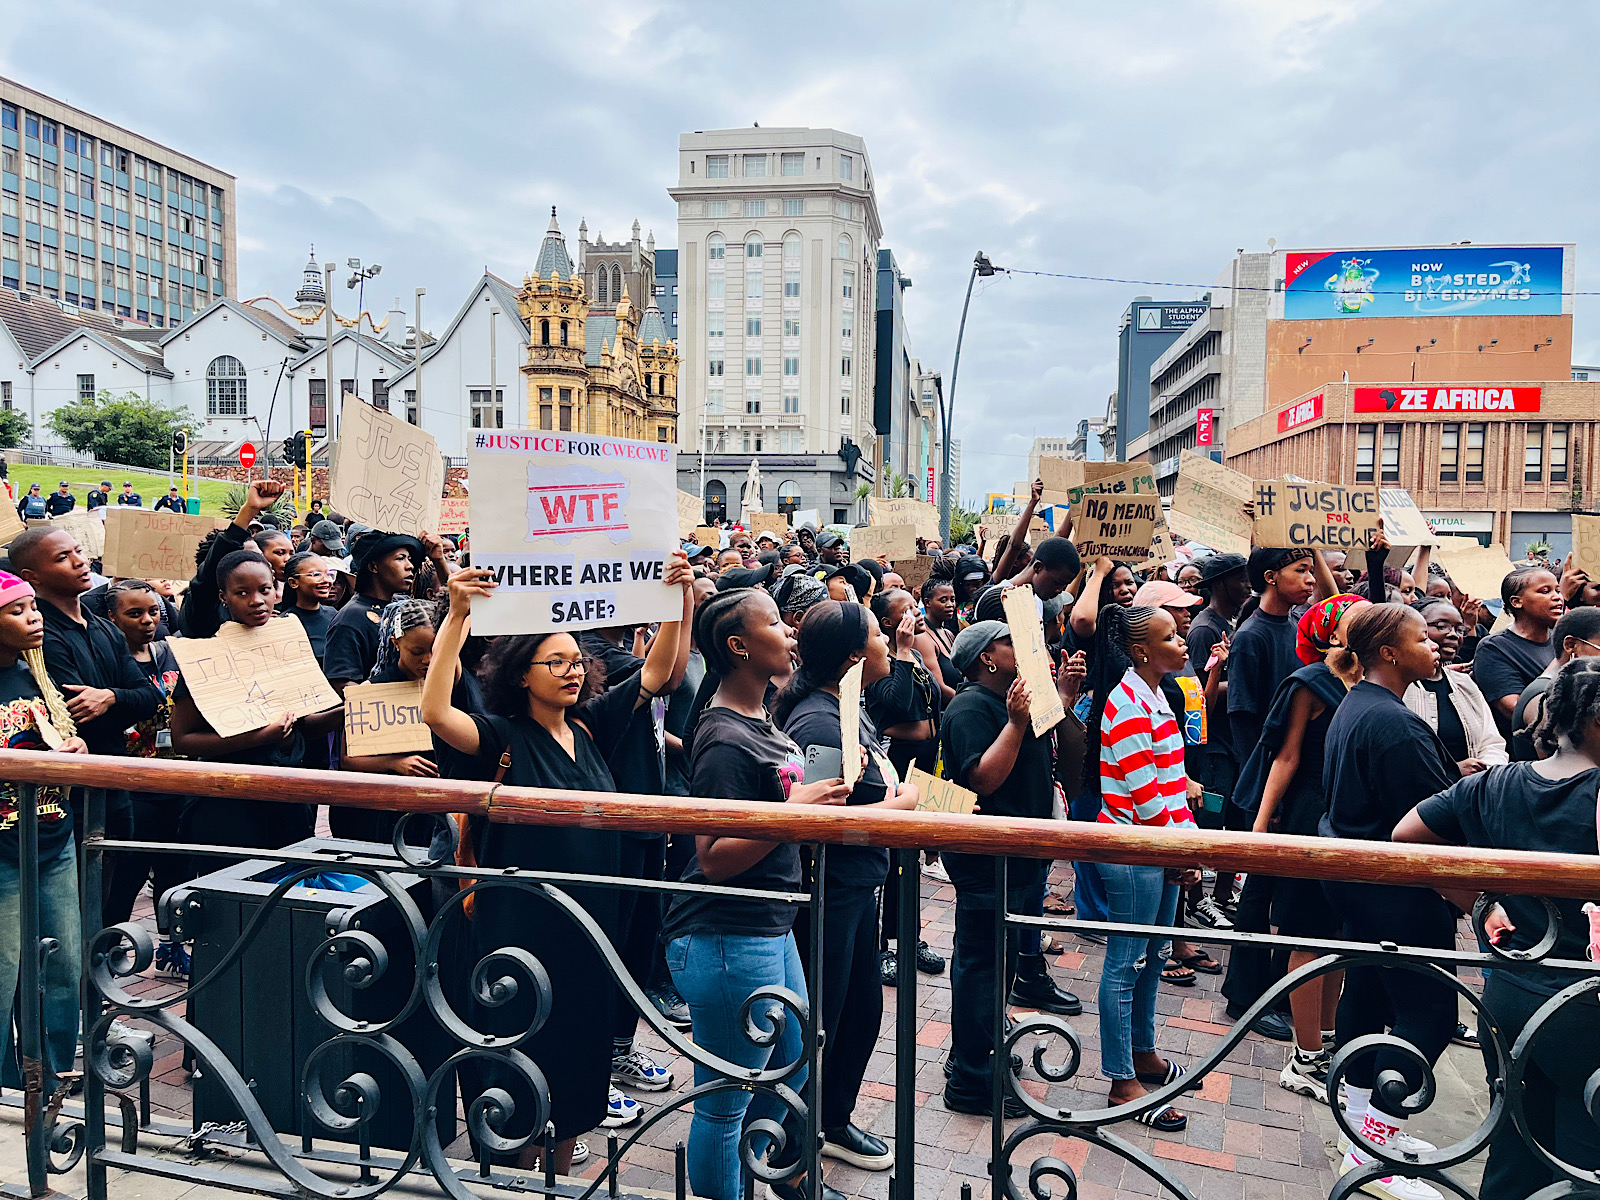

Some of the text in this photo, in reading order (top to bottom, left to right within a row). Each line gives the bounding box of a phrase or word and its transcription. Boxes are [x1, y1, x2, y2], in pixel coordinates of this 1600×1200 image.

[1293, 260, 1309, 275] NEW
[1411, 263, 1443, 272] NOW
[1400, 388, 1515, 410] ZE AFRICA
[1288, 399, 1315, 427] ZE AFRICA
[1199, 412, 1211, 442] KFC
[389, 479, 423, 511] 4
[1286, 485, 1377, 513] JUSTICE
[540, 492, 619, 525] WTF
[1086, 499, 1109, 521] NO
[1326, 512, 1351, 525] FOR
[1099, 521, 1132, 538] NO!!!
[157, 536, 174, 554] 4
[475, 560, 664, 586] WHERE ARE WE
[551, 599, 616, 624] SAFE?
[186, 640, 309, 686] JUSTICE
[245, 680, 275, 704] 4
